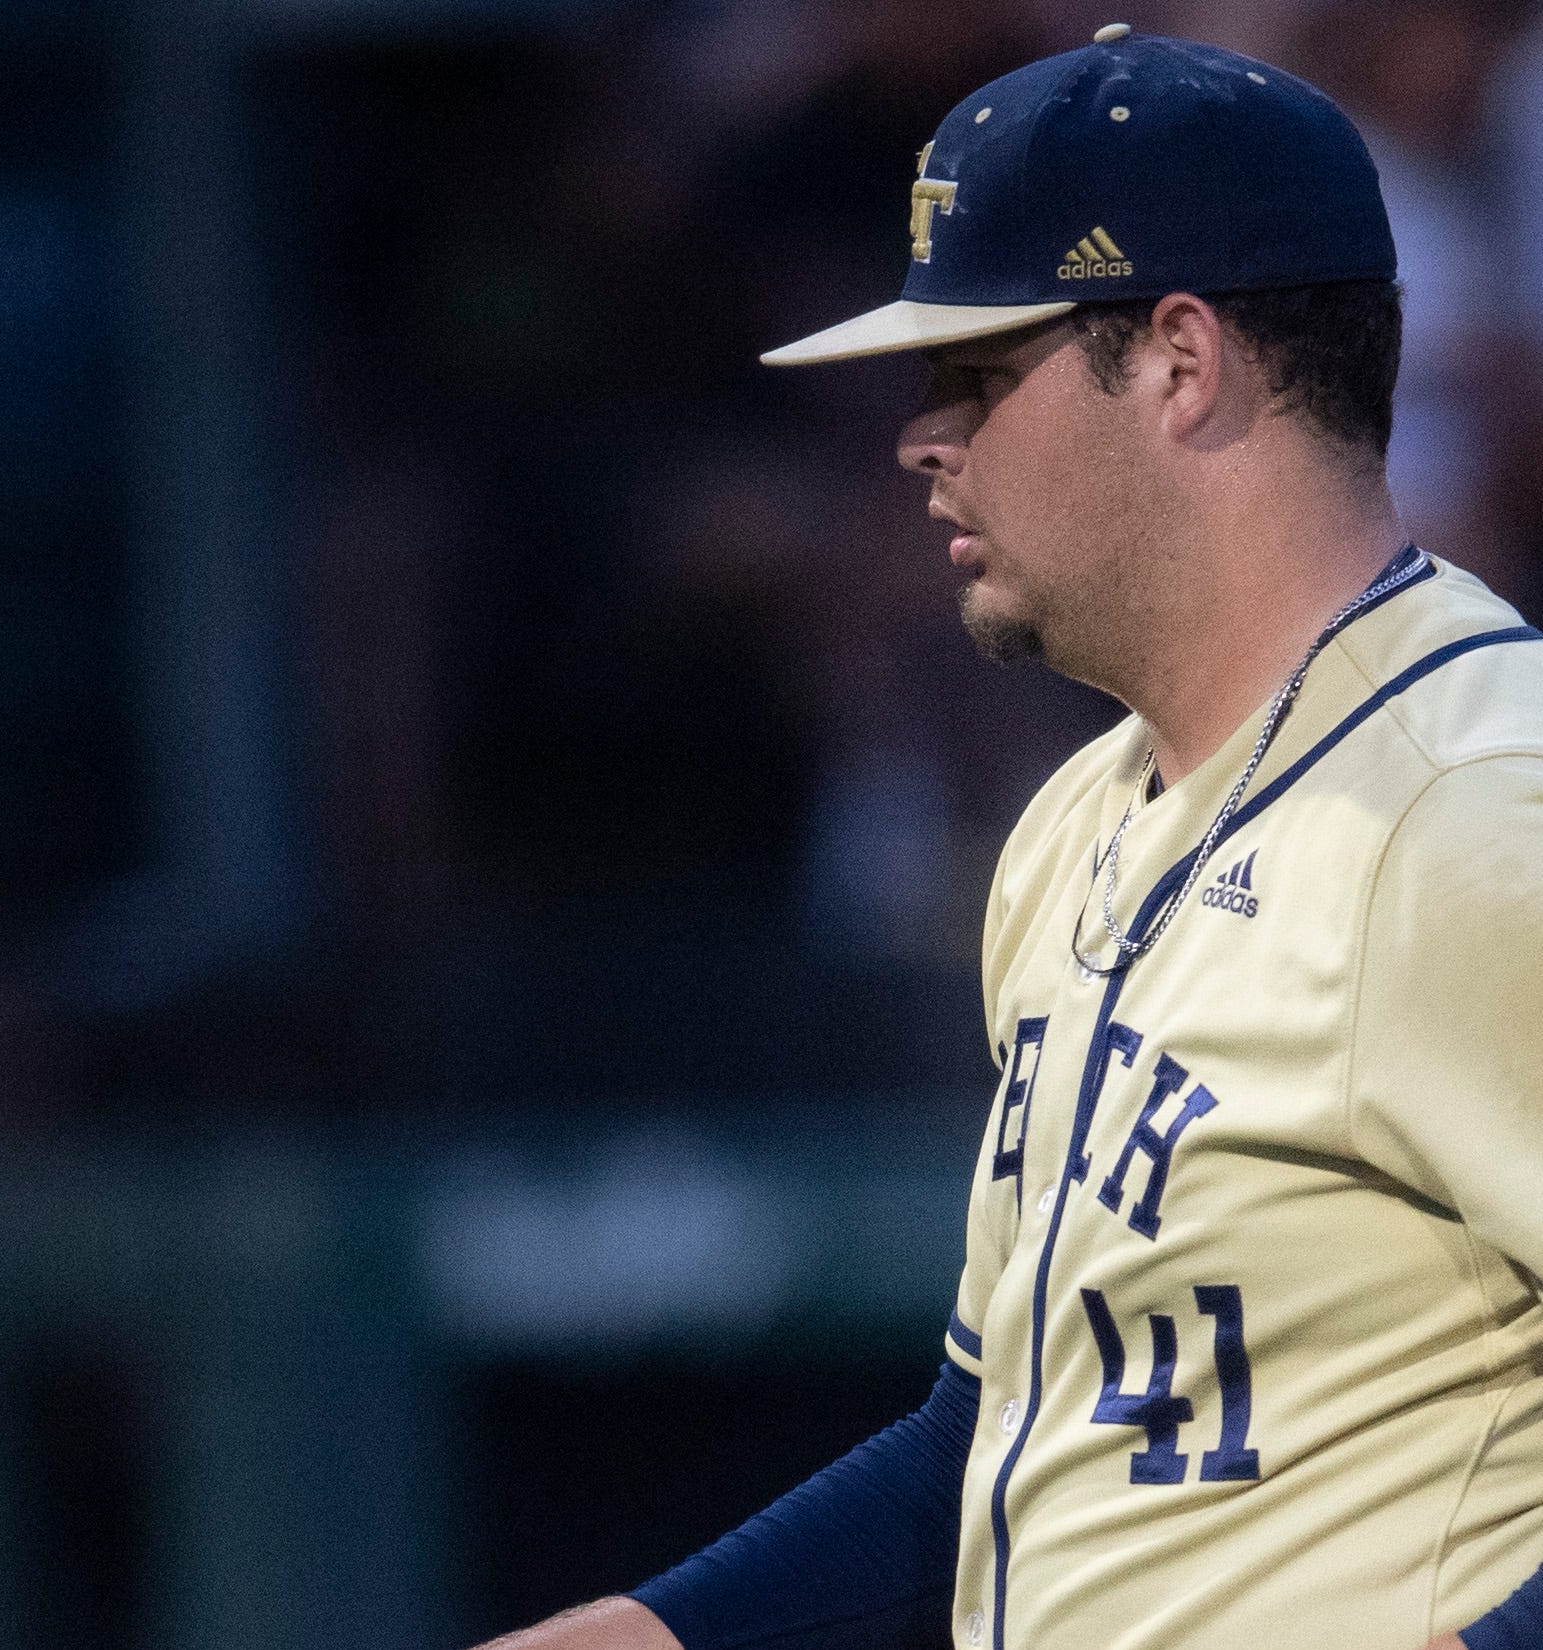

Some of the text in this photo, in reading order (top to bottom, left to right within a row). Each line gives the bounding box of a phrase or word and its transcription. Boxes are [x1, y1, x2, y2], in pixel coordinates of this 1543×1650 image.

[1056, 259, 1134, 279] adidas
[1201, 884, 1259, 918] adidas
[993, 1014, 1220, 1242] ECH
[1080, 1284, 1262, 1484] 41
